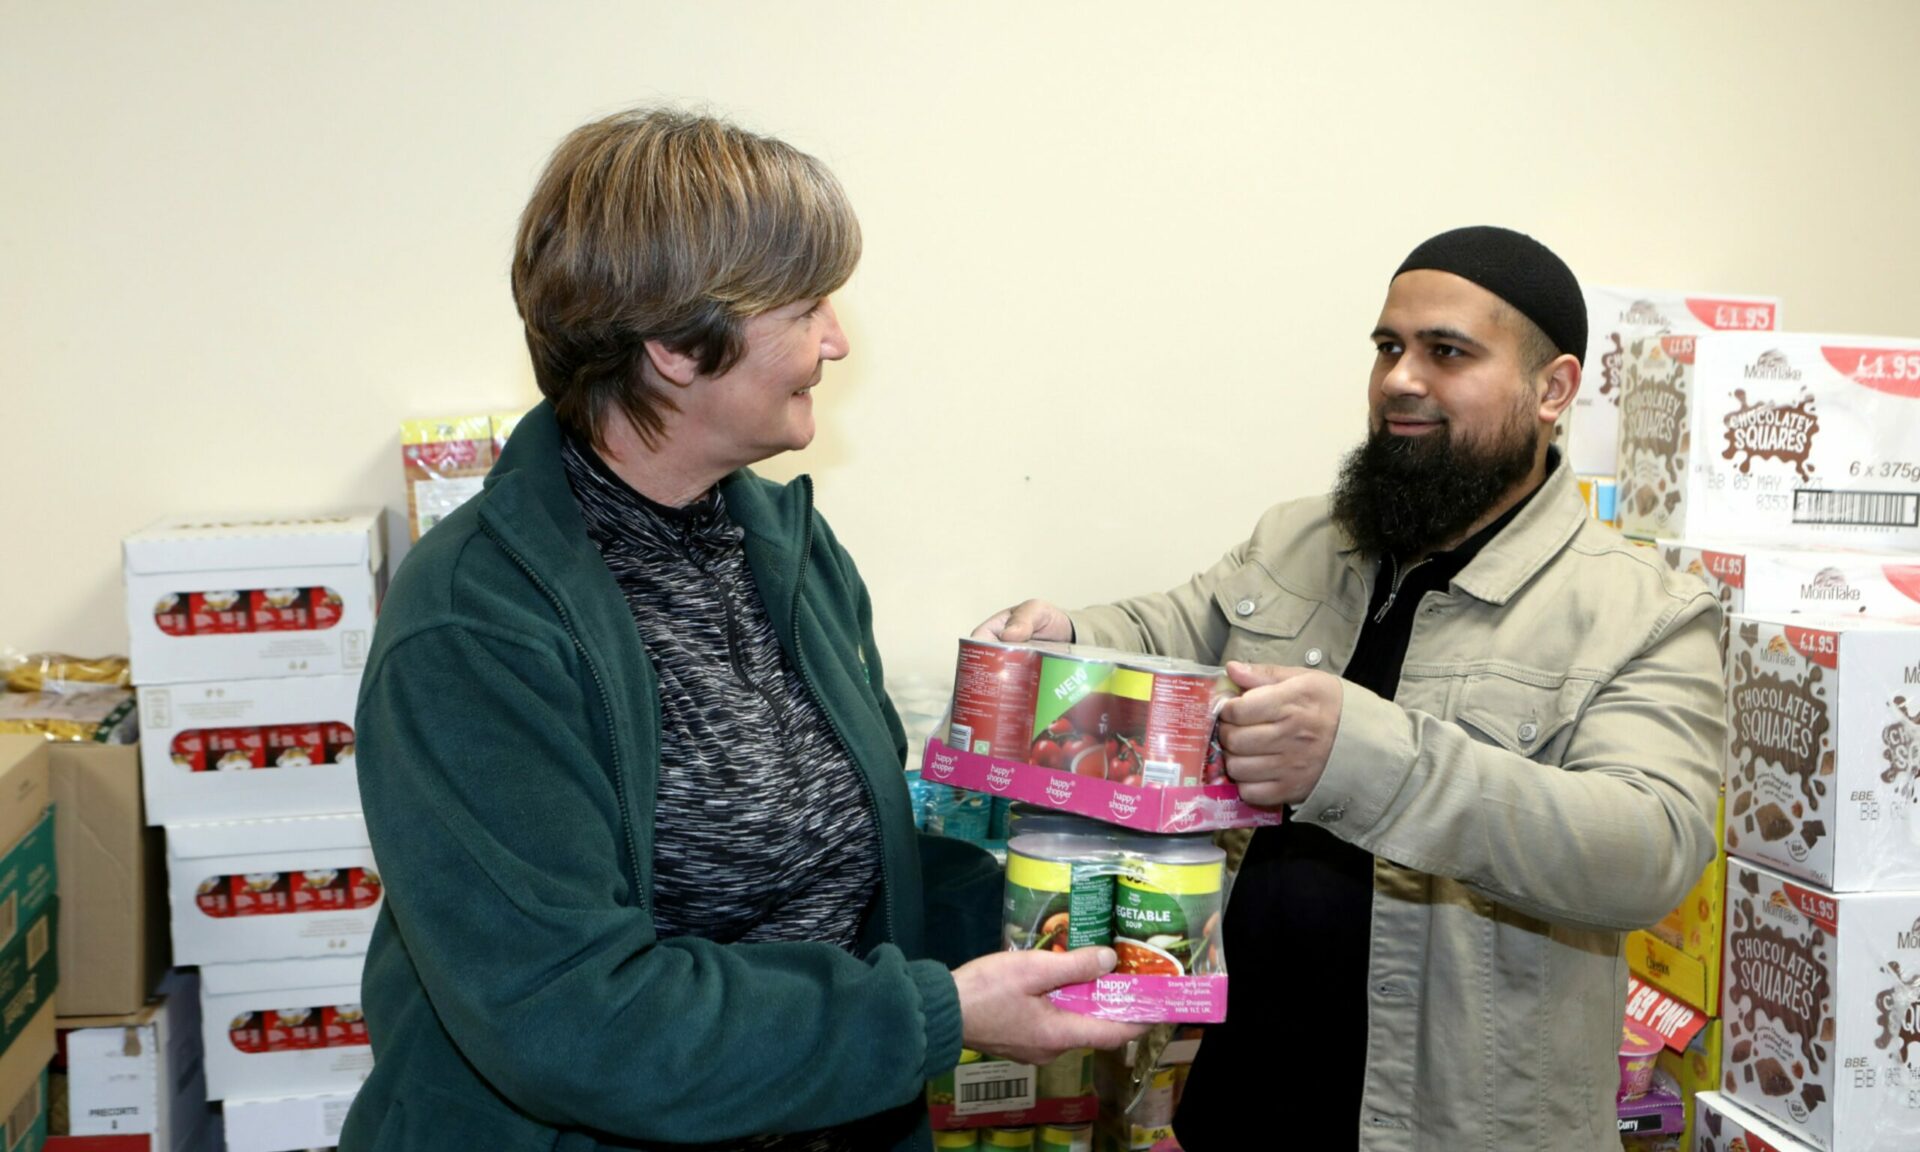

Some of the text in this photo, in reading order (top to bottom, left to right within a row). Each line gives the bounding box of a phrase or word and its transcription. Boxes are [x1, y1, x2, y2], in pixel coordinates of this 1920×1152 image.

[1715, 305, 1770, 329] £1.95
[1744, 364, 1802, 381] Mornflake
[1856, 354, 1920, 380] £1.95
[1626, 389, 1680, 416] CHOCOLATEY
[1629, 409, 1675, 442] SQUARES
[1729, 405, 1814, 433] CHOCOLATEY
[1734, 425, 1808, 453] SQUARES
[1849, 461, 1920, 482] 6 x 375g
[1713, 555, 1742, 575] £1.95
[1800, 584, 1861, 601] Mornflake
[1800, 632, 1835, 654] £1.95
[1760, 648, 1797, 667] Mornflake
[1054, 666, 1088, 700] NEW
[1737, 687, 1820, 729] CHOCOLATEY
[1741, 709, 1813, 759] SQUARES
[931, 761, 955, 773] shopper
[935, 752, 953, 765] happy
[987, 773, 1012, 786] shopper
[990, 764, 1009, 778] happy
[1046, 786, 1072, 800] shopper
[1050, 776, 1071, 791] happy
[1113, 790, 1135, 805] happy
[1108, 801, 1138, 815] shopper
[1115, 904, 1171, 922] EGETABLE
[1762, 900, 1799, 926] Mornflake
[1801, 893, 1834, 921] £1.95
[1125, 920, 1142, 929] SOUP
[1737, 938, 1822, 992] CHOCOLATEY
[1096, 978, 1132, 993] happy
[1740, 960, 1814, 1020] SQUARES
[1647, 997, 1695, 1039] PMP
[1616, 1118, 1639, 1132] Curry
